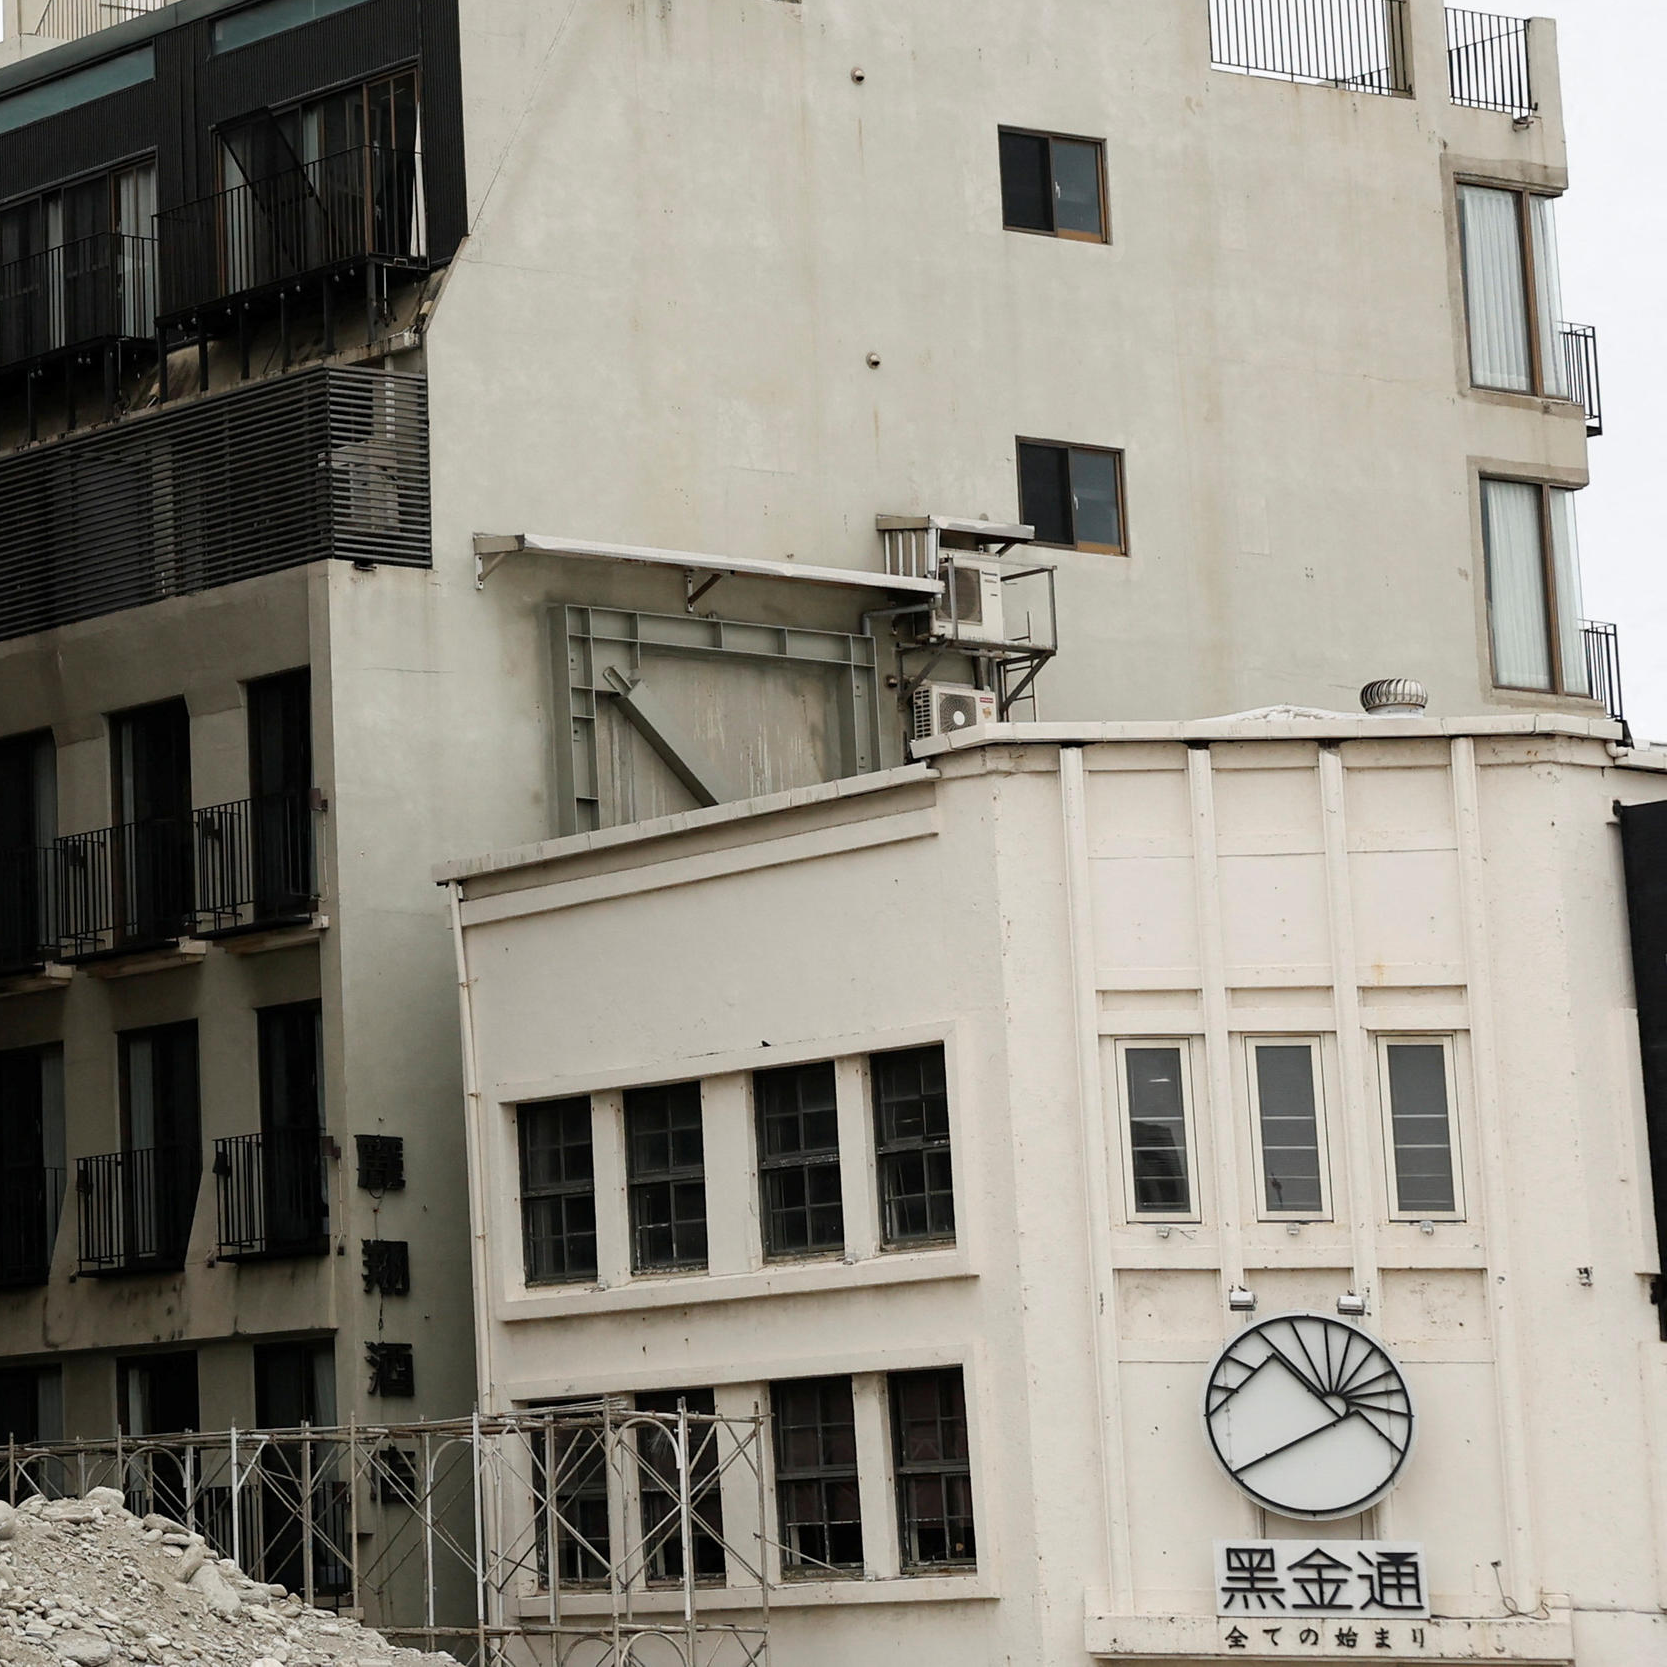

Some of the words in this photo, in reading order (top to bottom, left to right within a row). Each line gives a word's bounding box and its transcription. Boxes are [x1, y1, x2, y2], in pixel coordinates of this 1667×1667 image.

[1221, 1547, 1425, 1611] 黑金通
[1224, 1626, 1425, 1650] 全ての始まり
